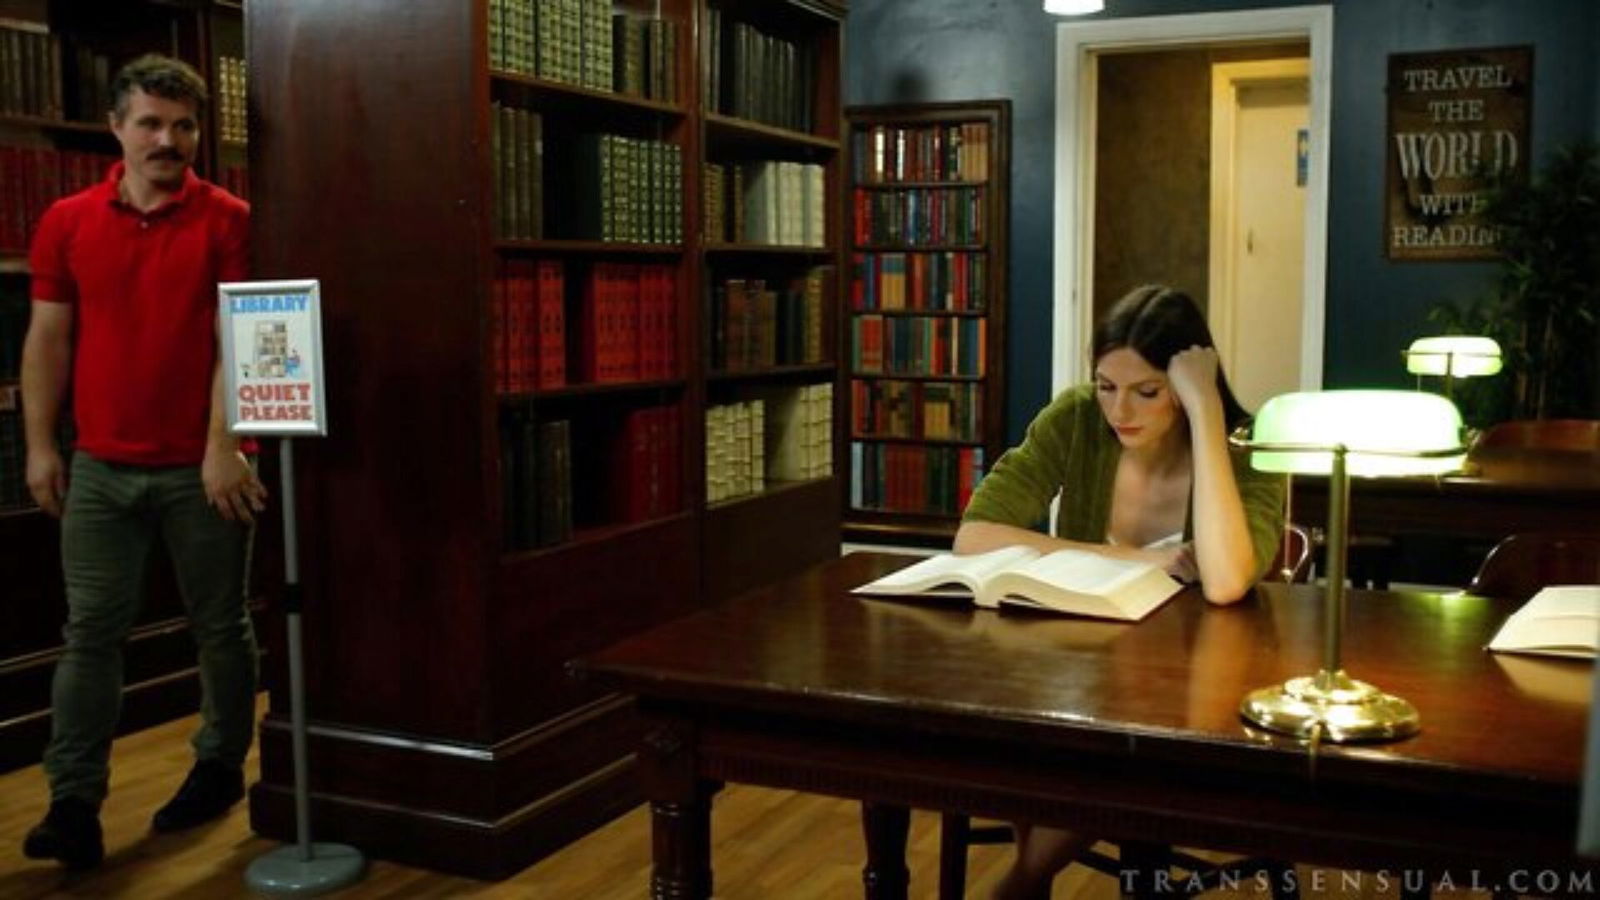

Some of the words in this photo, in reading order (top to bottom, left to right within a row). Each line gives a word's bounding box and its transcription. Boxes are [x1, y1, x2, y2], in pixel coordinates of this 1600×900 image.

[1404, 65, 1513, 92] TRAVEL
[1428, 100, 1485, 123] THE
[1391, 224, 1504, 248] READIN
[230, 293, 308, 314] LIBRARY
[239, 382, 311, 405] QUIET
[239, 404, 313, 421] PLEASE
